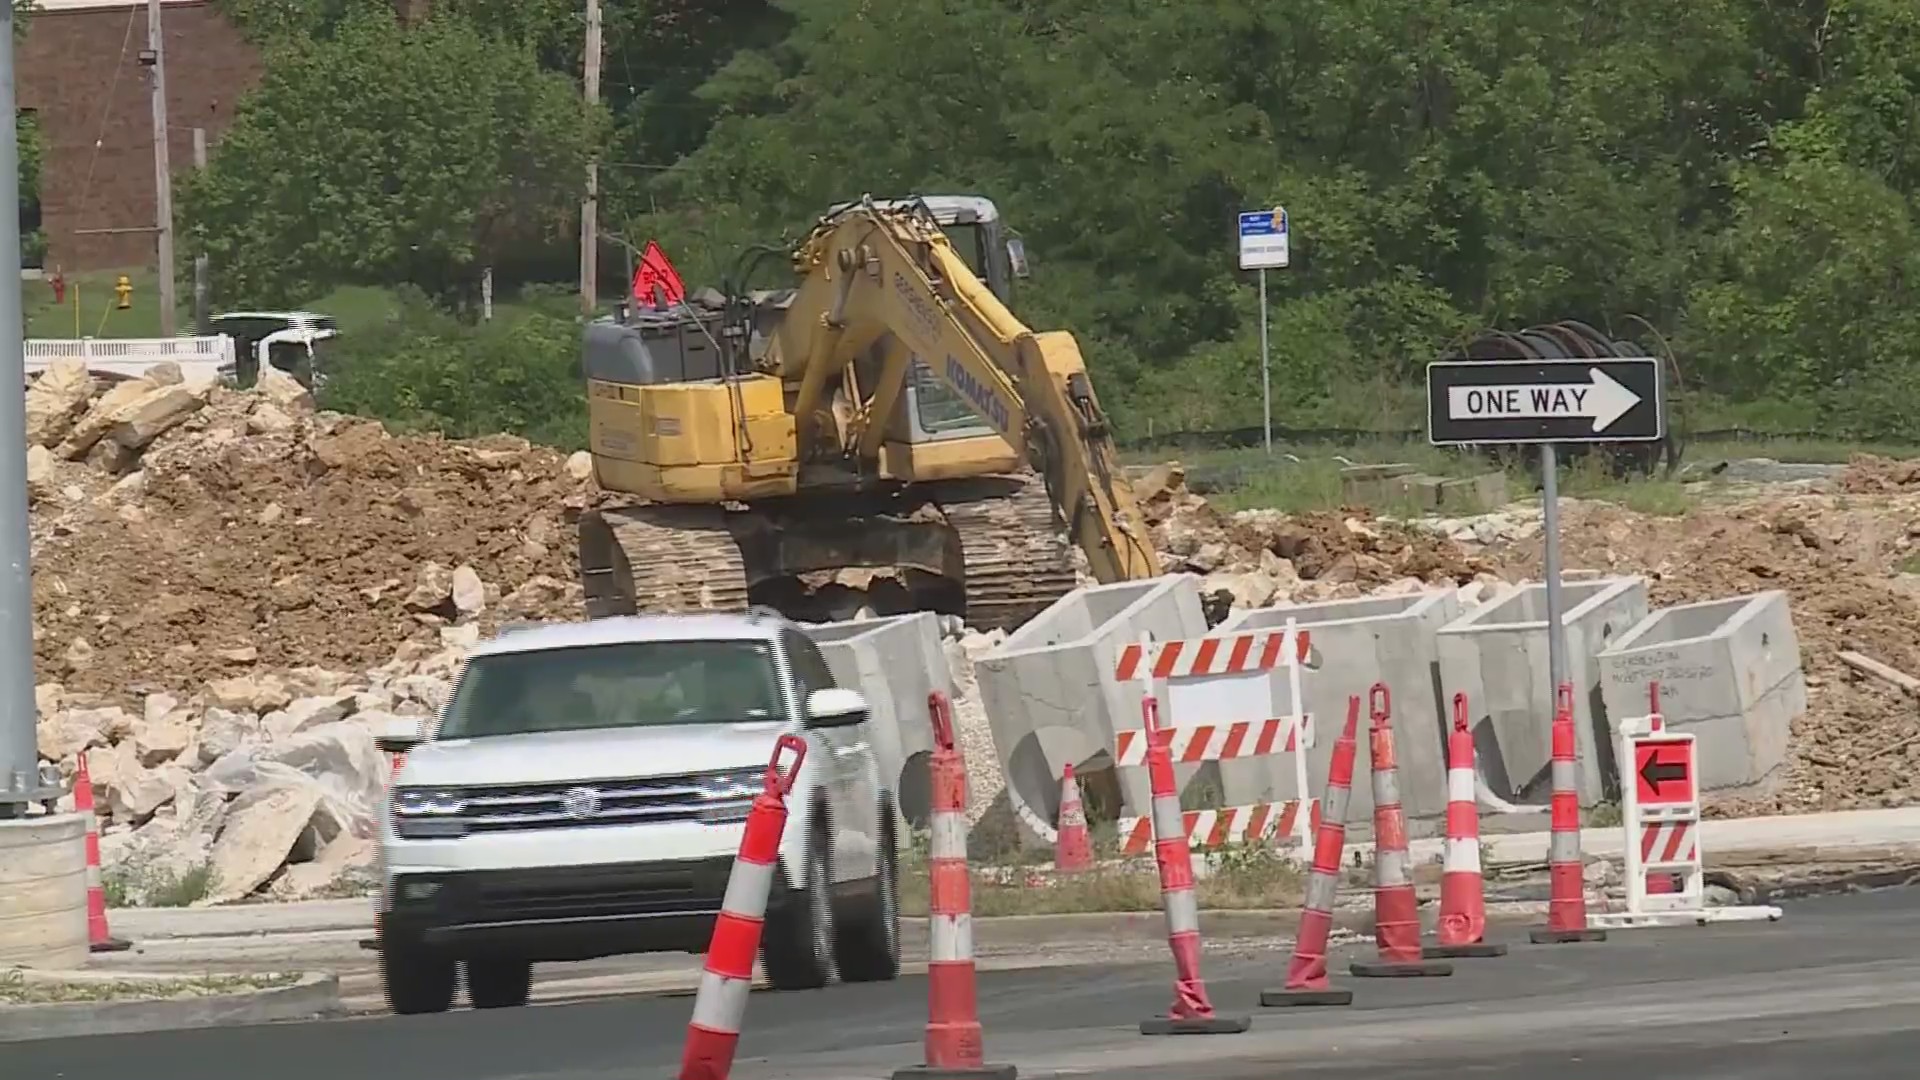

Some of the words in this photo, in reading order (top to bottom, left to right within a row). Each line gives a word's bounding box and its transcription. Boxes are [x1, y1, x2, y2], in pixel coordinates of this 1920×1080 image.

[946, 352, 1009, 432] KOMATSU
[1467, 389, 1521, 414] ONE
[1530, 388, 1588, 413] WAY
